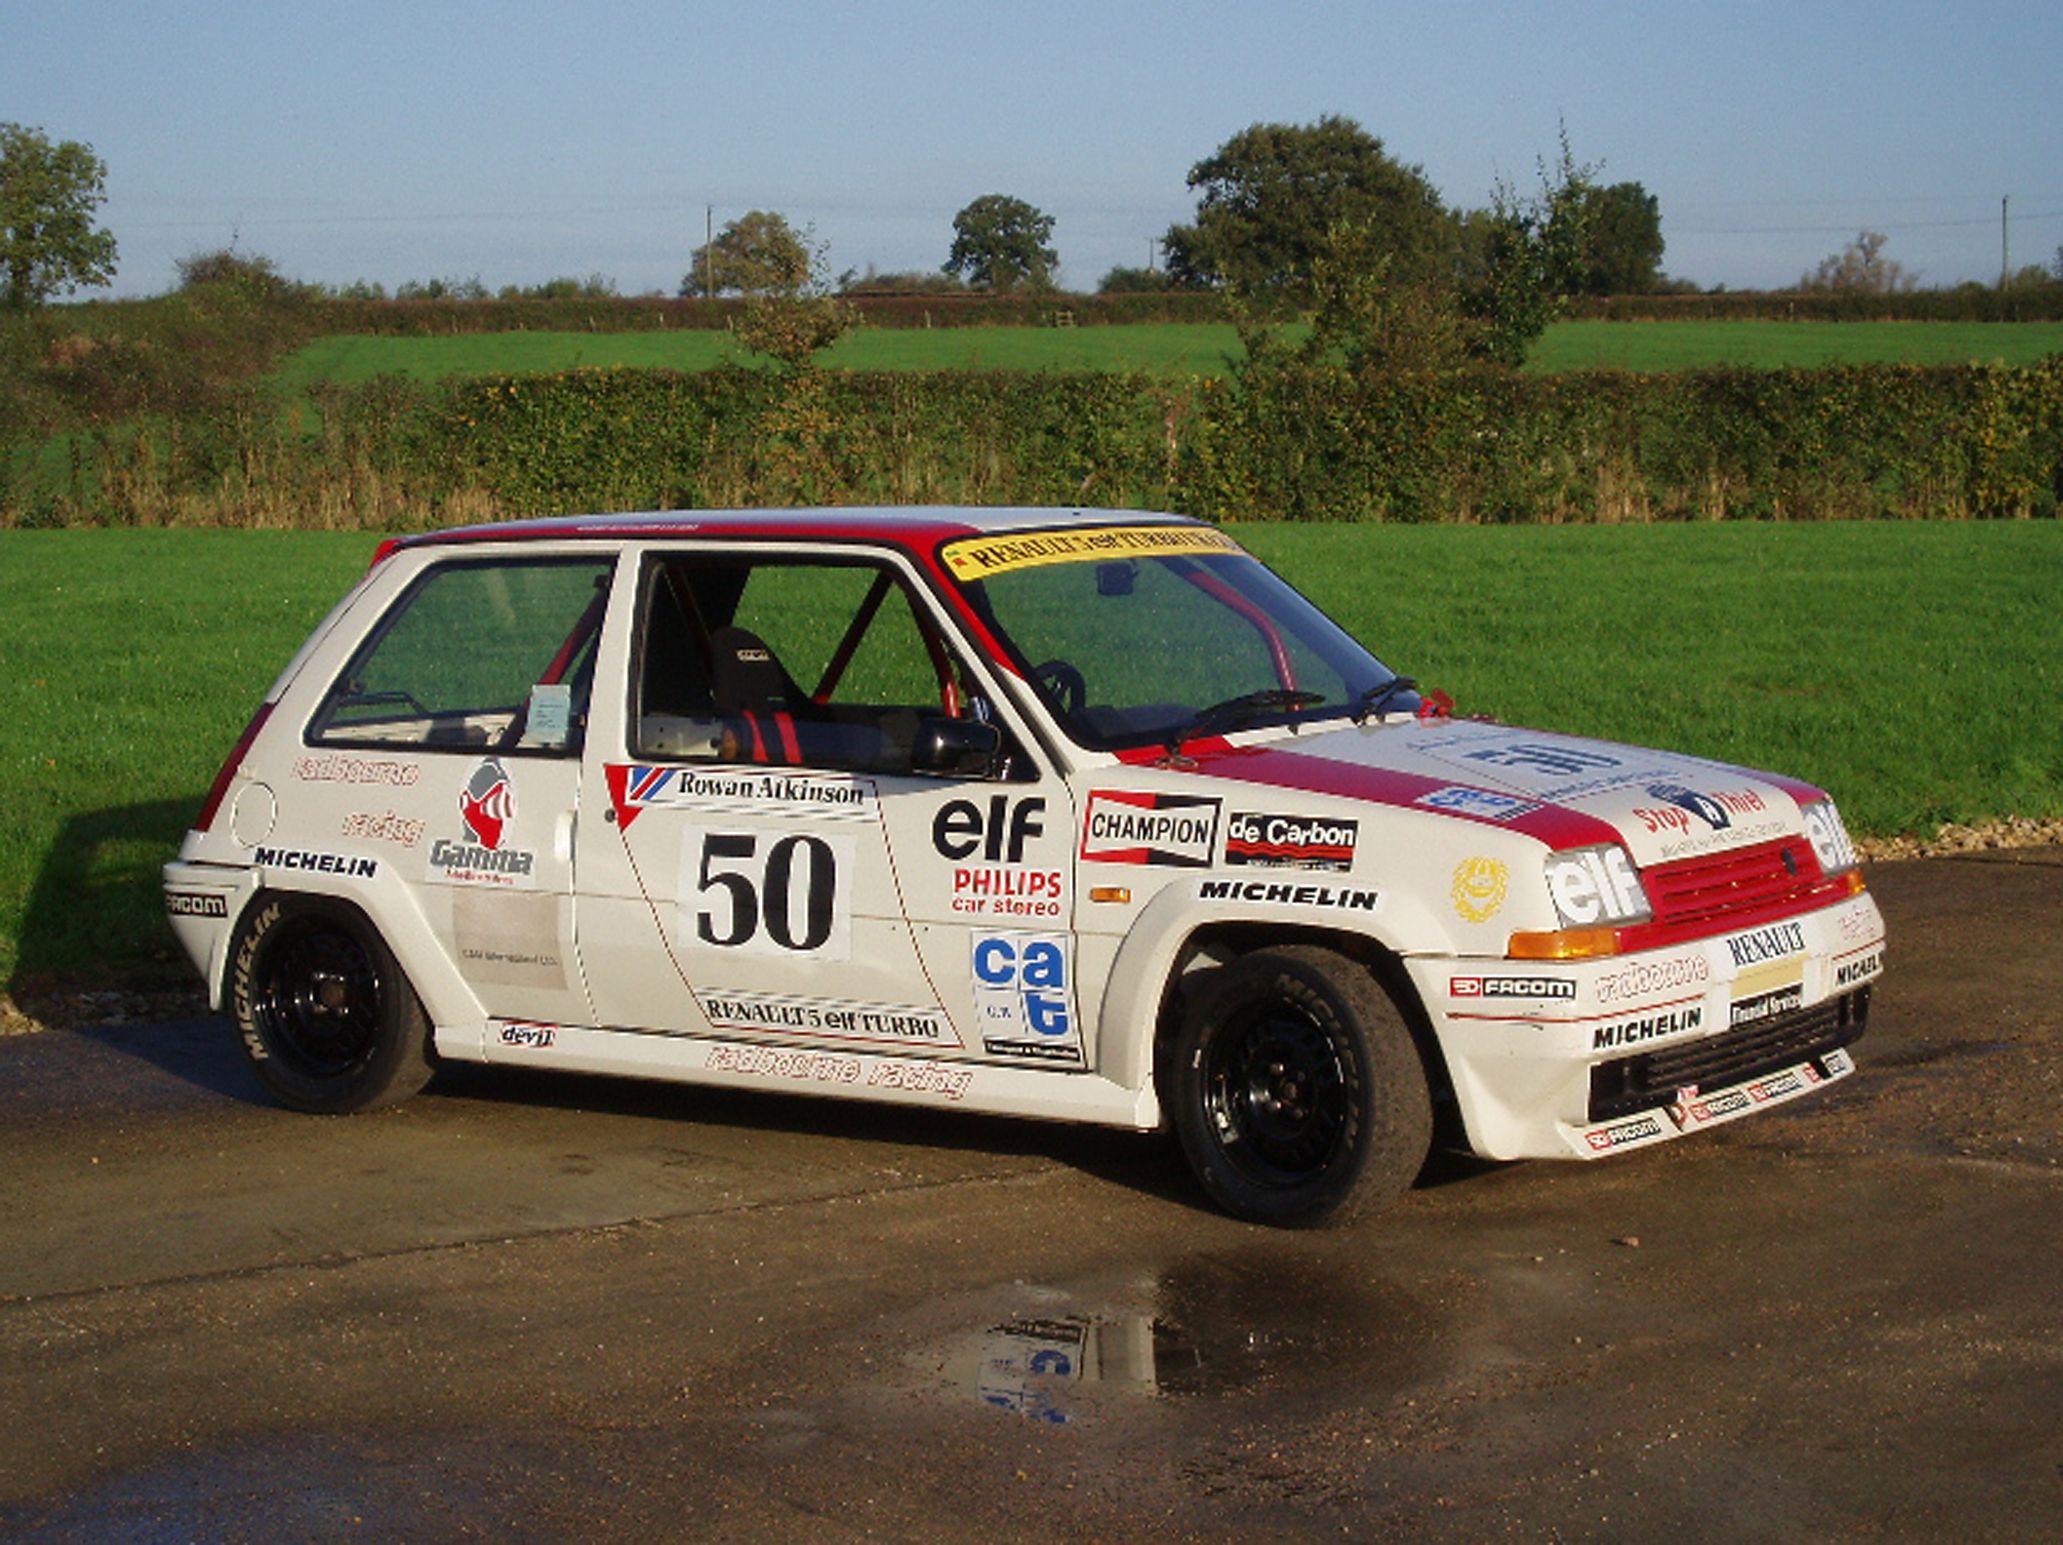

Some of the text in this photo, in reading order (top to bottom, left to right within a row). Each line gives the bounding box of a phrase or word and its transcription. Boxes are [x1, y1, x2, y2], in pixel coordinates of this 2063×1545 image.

[968, 535, 1076, 570] RENAULT
[679, 772, 864, 805] Rowan Atkinson
[932, 794, 1046, 863] elf
[1091, 813, 1209, 843] CHAMPION
[1230, 816, 1354, 846] de Carbon
[1633, 805, 1690, 836] Stop
[254, 847, 378, 878] MICHELIN
[430, 839, 533, 875] Gamma
[697, 833, 836, 950] 50
[954, 868, 1061, 898] PHILIPS
[1199, 882, 1379, 911] MICHELIN
[1551, 846, 1642, 923] elf
[951, 897, 1061, 916] car stereo
[1727, 922, 1806, 968] RENAULT
[234, 902, 281, 1061] MICHELIN
[1484, 979, 1575, 999] FACOM
[706, 999, 938, 1038] RENAULT 5 elf TURBO
[1592, 1007, 1702, 1050] MICHELIN
[502, 1026, 552, 1046] devil
